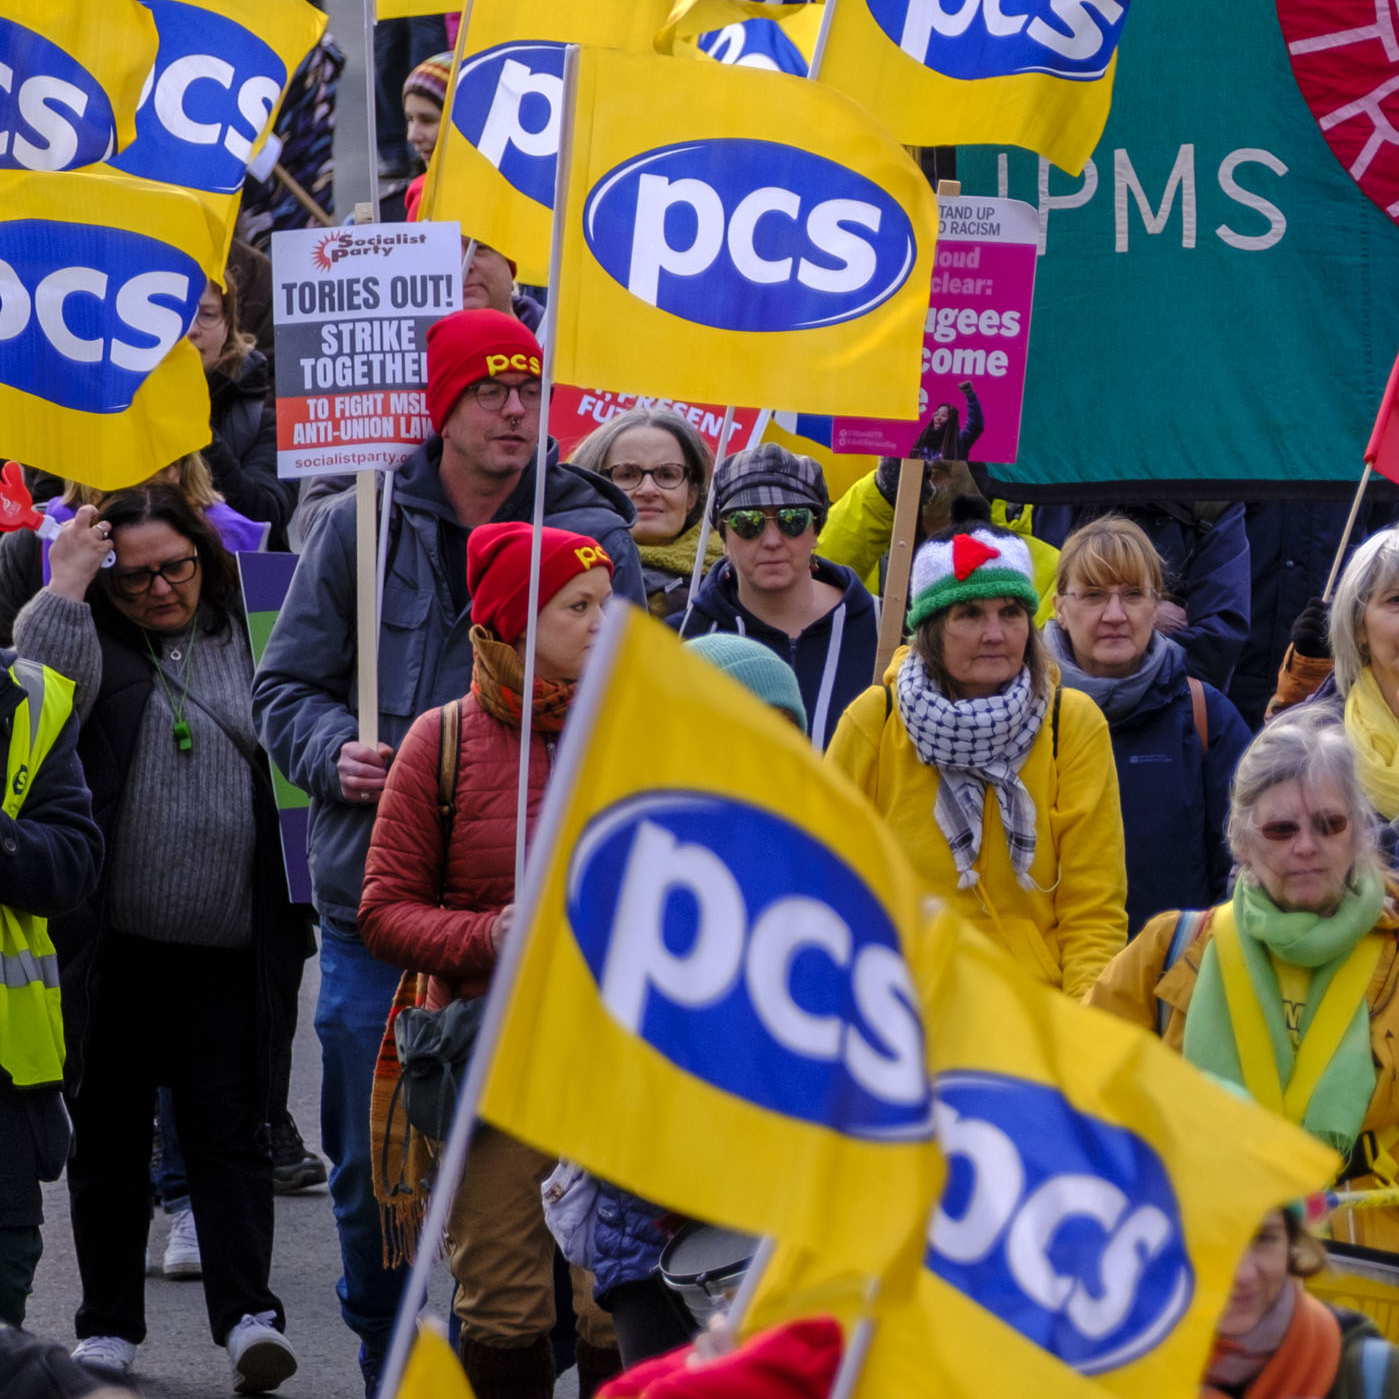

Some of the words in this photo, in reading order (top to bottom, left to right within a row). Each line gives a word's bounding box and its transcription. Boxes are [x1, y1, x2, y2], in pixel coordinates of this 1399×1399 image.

[137, 53, 283, 165] cs
[939, 205, 973, 220] TAND
[976, 206, 995, 220] UP
[338, 232, 426, 249] Socialist
[628, 173, 883, 309] pcs
[950, 222, 1001, 236] RACISM
[281, 276, 381, 316] TORIES
[390, 274, 454, 308] OUT!
[321, 319, 416, 355] STRIKE
[486, 353, 541, 378] pcs
[921, 347, 1009, 378] come
[307, 398, 329, 420] TO
[335, 394, 384, 417] FIGHT
[293, 417, 395, 445] ANTI-UNION
[574, 545, 611, 570] pc
[603, 818, 928, 1107] pcs
